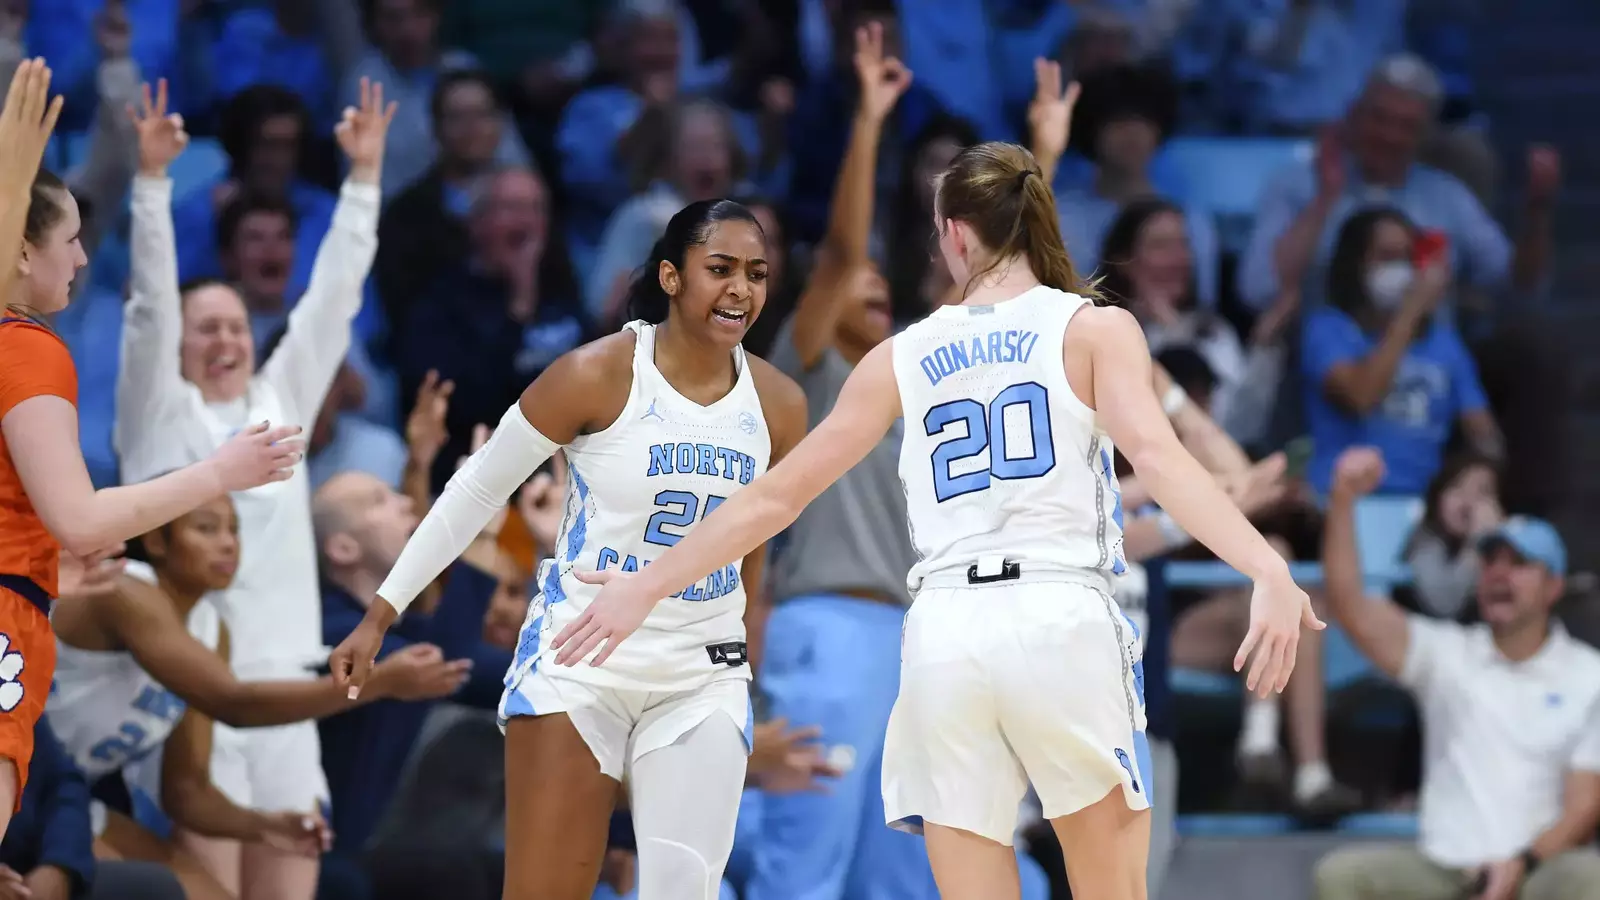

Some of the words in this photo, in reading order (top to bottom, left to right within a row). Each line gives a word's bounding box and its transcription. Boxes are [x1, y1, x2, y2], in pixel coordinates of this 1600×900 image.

[920, 329, 1040, 386] DONARSKI
[647, 442, 756, 486] NORTH
[923, 381, 1056, 503] 20
